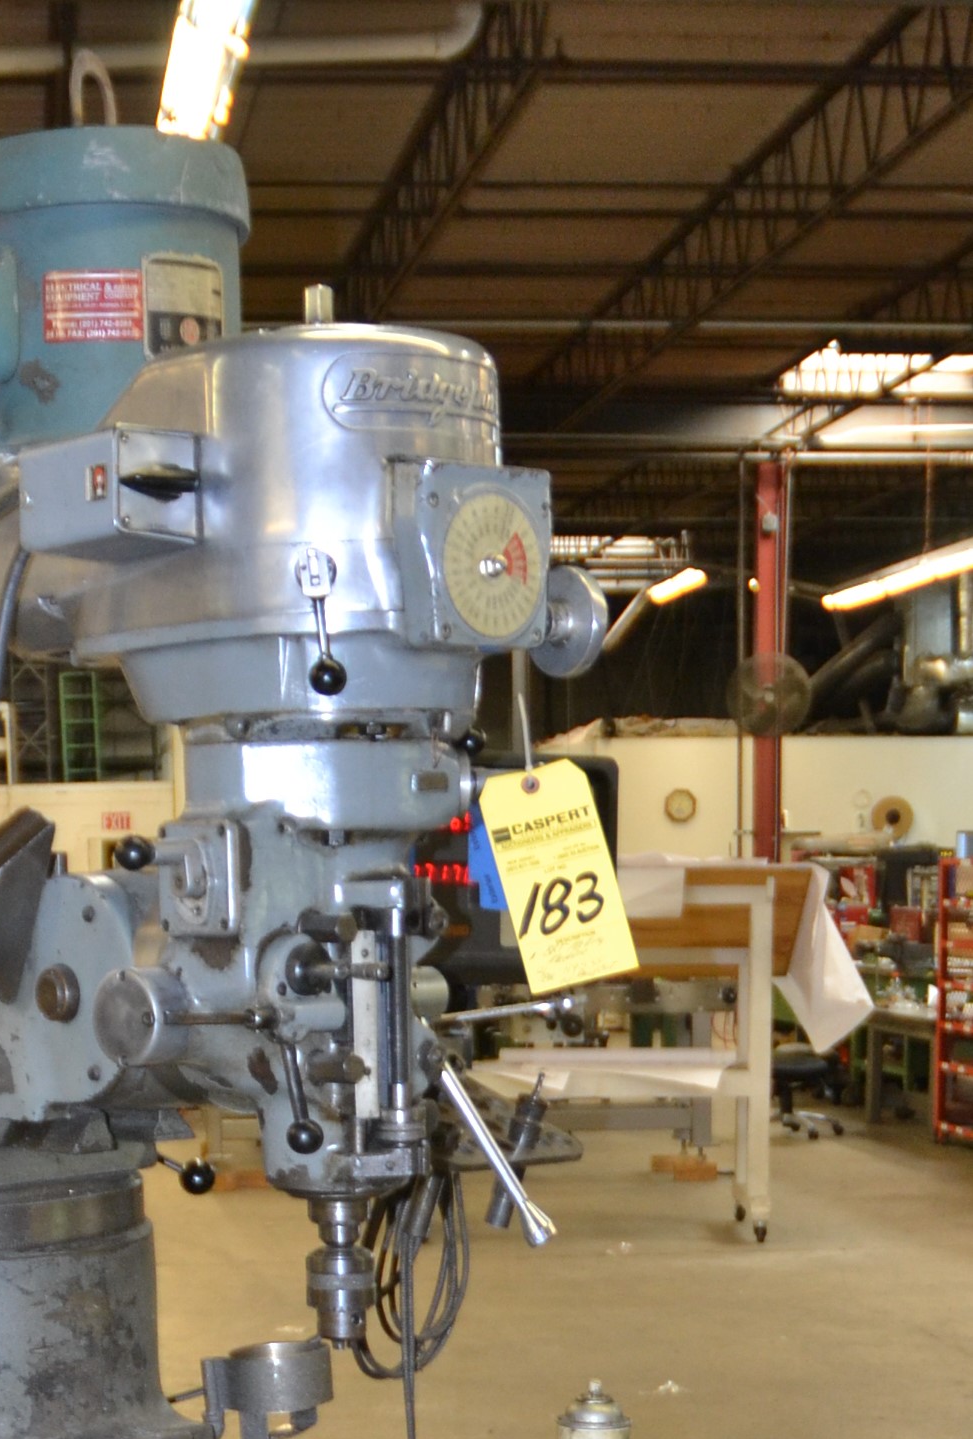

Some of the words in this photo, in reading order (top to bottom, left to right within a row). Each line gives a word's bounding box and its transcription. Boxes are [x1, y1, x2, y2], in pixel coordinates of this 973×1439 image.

[103, 813, 130, 830] EXIT
[511, 805, 590, 835] CASPERT
[519, 871, 604, 940] 183
